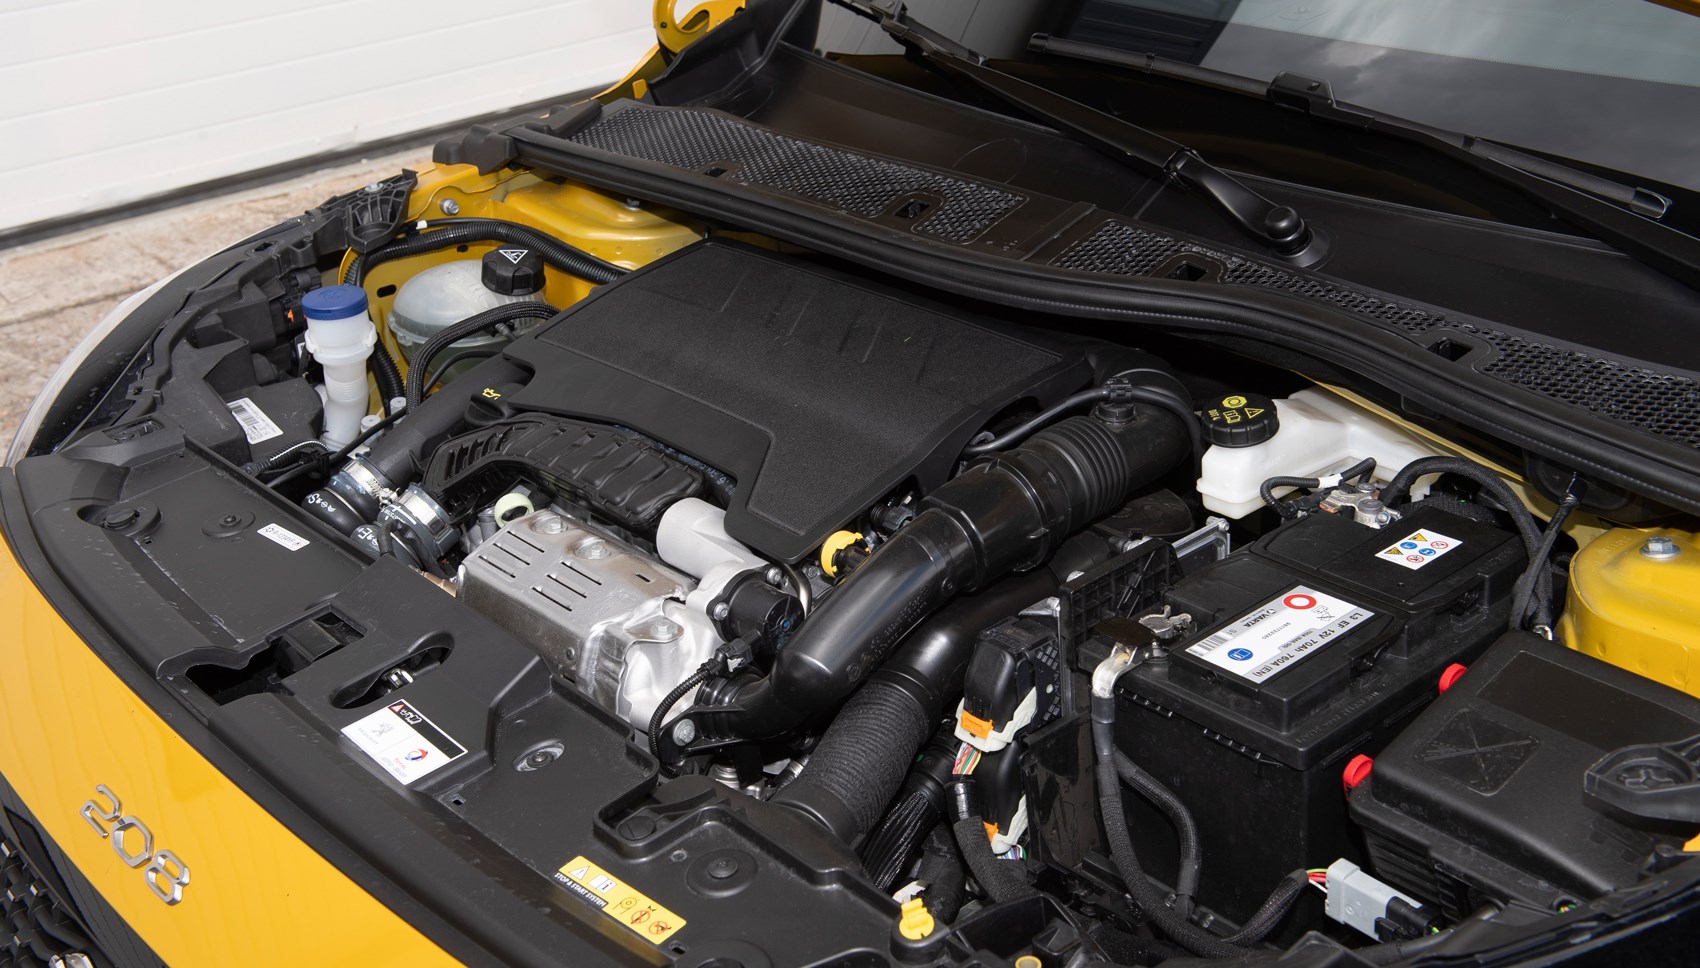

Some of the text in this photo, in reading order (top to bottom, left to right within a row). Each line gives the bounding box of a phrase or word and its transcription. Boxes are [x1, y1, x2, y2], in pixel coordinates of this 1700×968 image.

[1241, 612, 1269, 627] VARTA
[1251, 612, 1363, 677] L3 EF 12V 70Ah 760A (EN)
[80, 784, 191, 906] 208
[554, 872, 570, 883] STOP
[571, 883, 588, 895] START
[585, 892, 607, 907] SYSTEM
